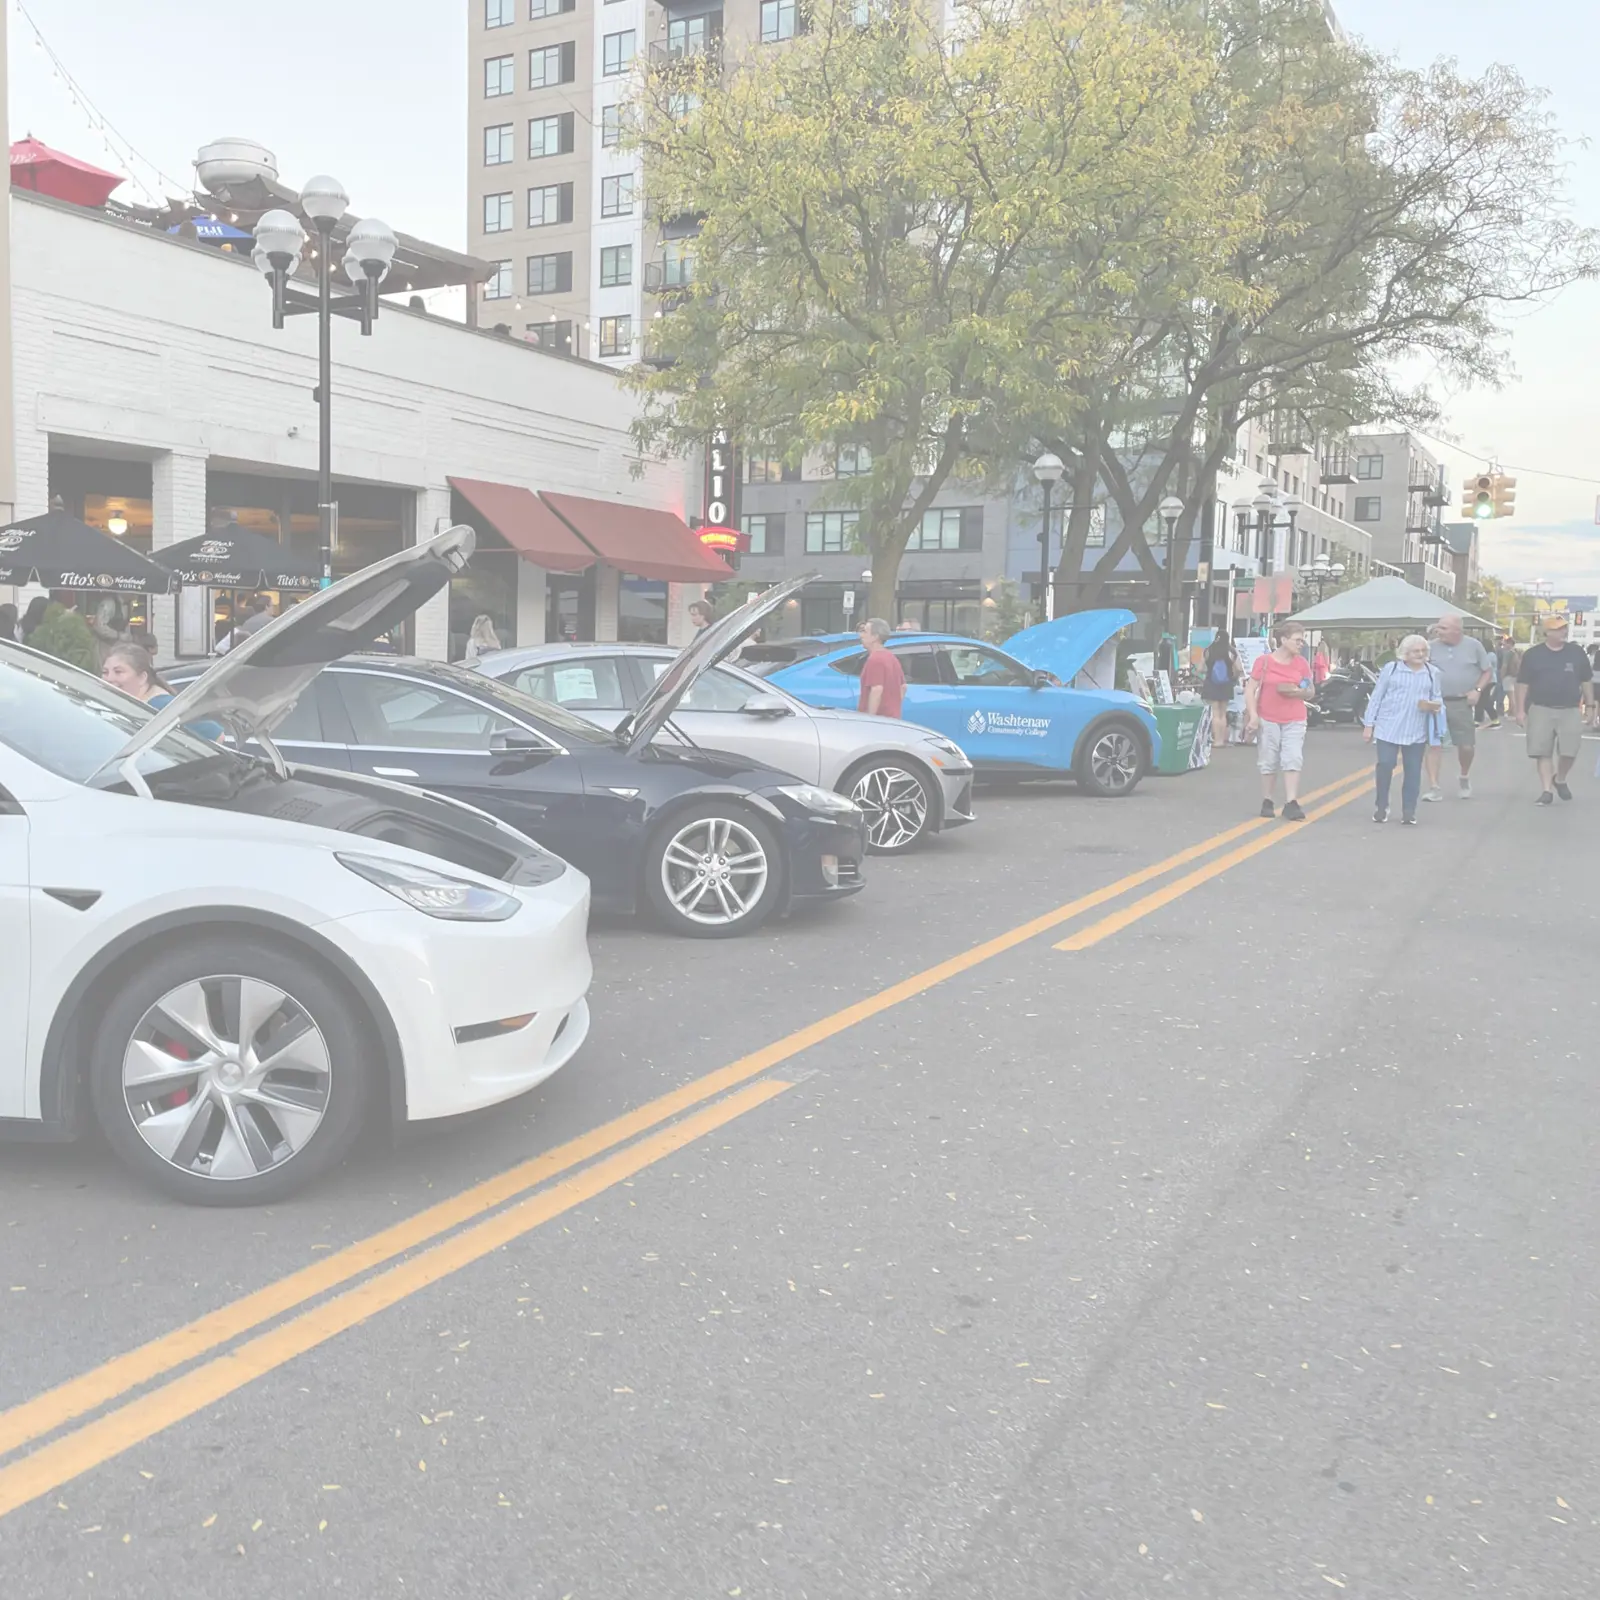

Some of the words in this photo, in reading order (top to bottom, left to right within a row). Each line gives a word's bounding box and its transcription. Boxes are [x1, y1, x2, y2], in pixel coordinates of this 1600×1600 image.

[60, 572, 96, 586] Tito's
[277, 575, 299, 586] Tito's
[987, 712, 1052, 728] Washtenaw
